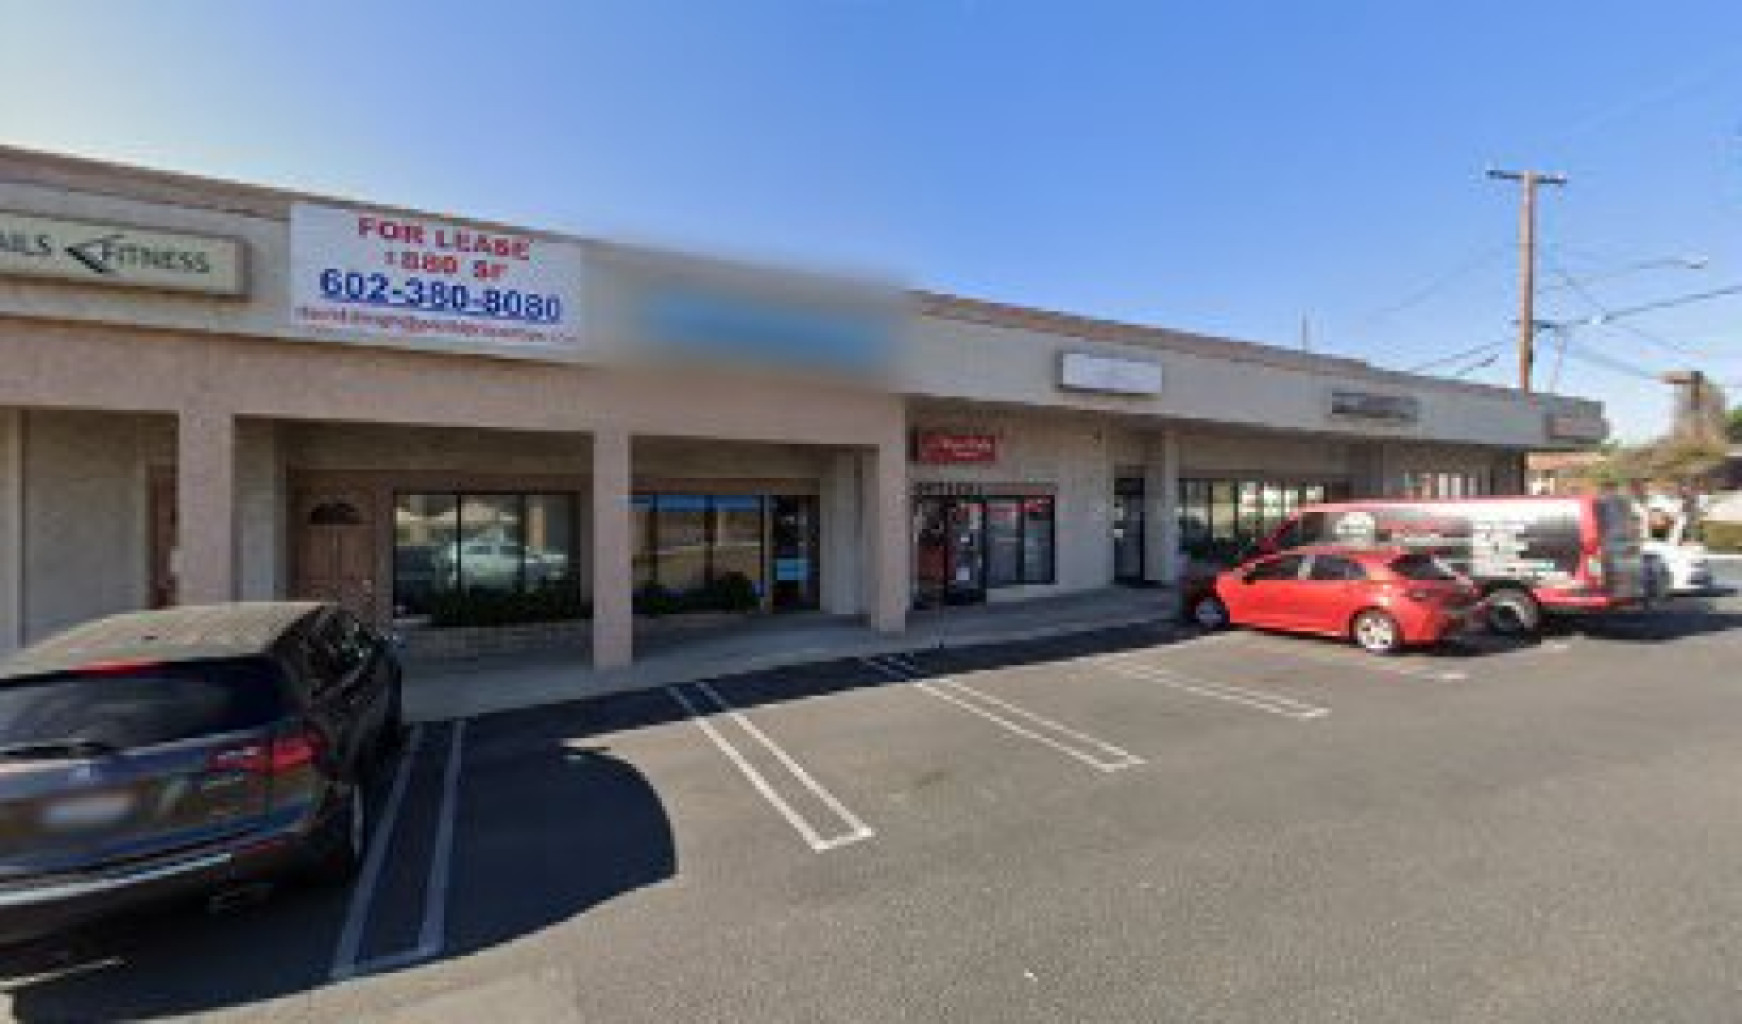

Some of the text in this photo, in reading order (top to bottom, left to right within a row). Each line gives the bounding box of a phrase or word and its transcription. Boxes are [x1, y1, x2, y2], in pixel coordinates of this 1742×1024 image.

[99, 235, 210, 274] FITNESS
[359, 217, 531, 261] FOR LEASE
[319, 268, 562, 324] 602-380-8080
